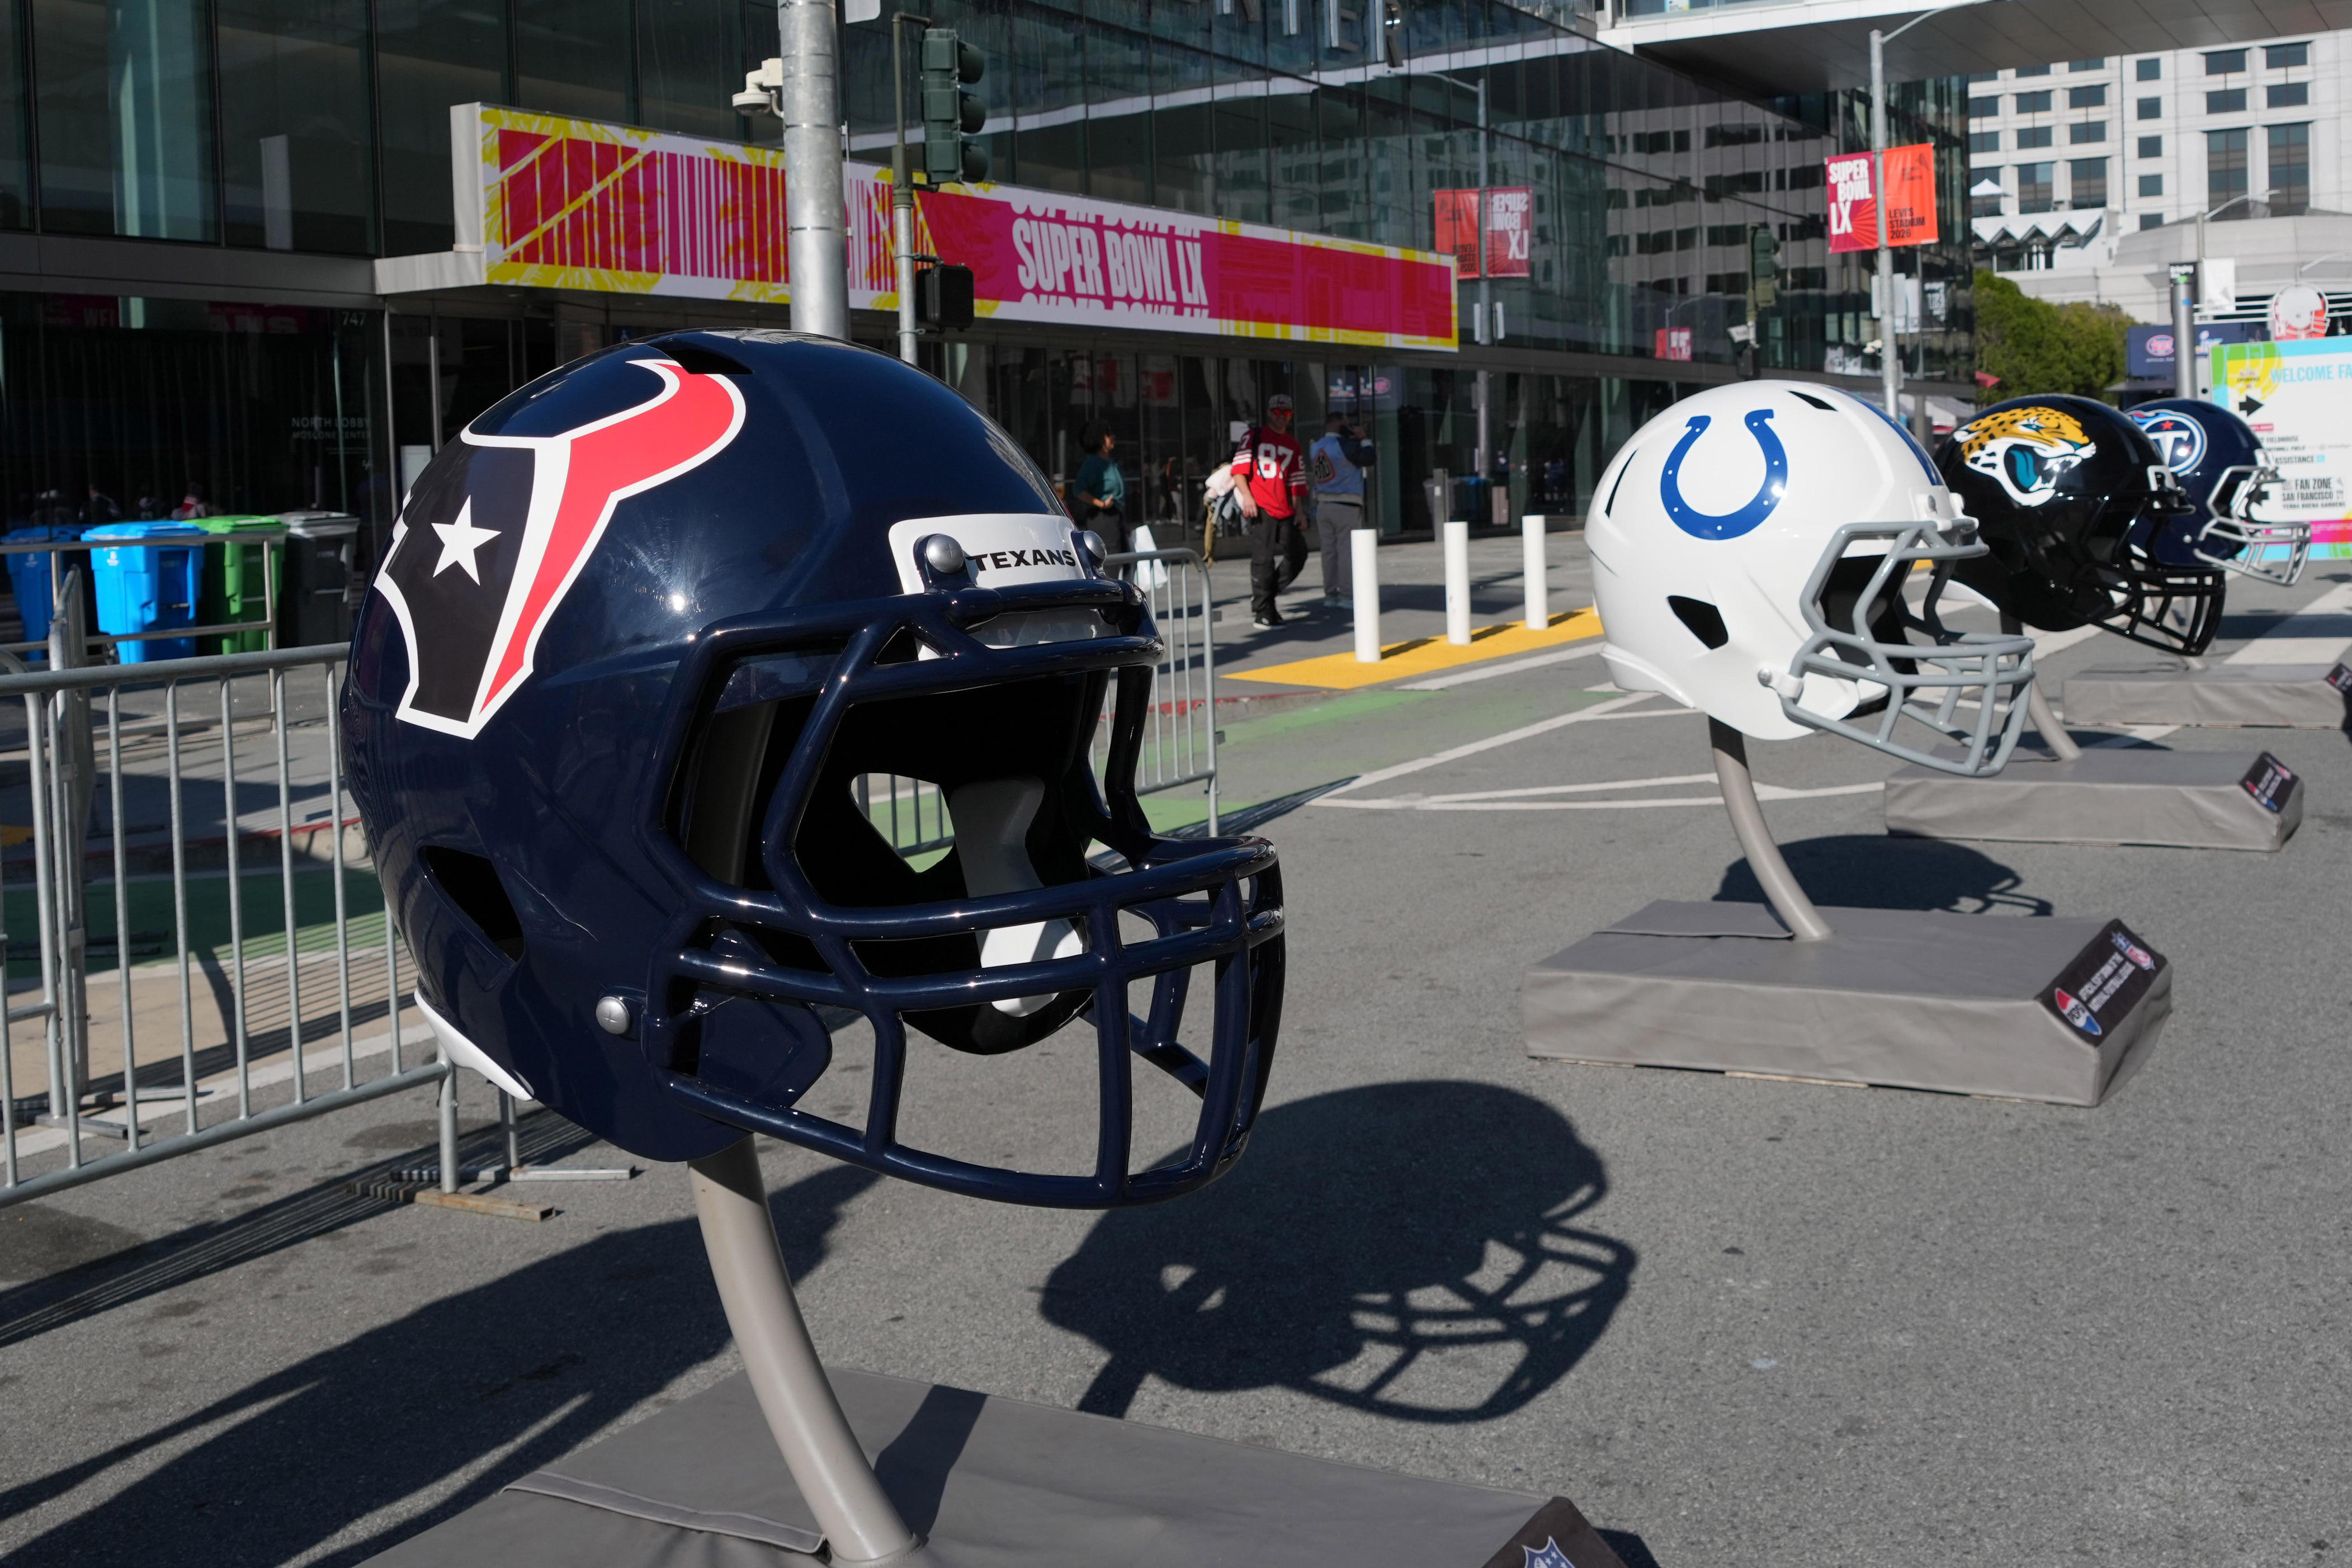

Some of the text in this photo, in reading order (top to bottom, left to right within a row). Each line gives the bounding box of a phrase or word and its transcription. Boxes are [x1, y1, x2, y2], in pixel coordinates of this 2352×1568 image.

[1829, 158, 1869, 184] SUPER
[1837, 179, 1872, 202] BOWL
[1830, 201, 1853, 235] LX
[1888, 207, 1914, 219] LEVI'S
[1890, 216, 1925, 229] STADIUM
[1890, 229, 1911, 239] 2026
[1012, 218, 1106, 296] SUPER
[1104, 230, 1177, 303] BOWL
[1175, 239, 1208, 305] LX
[342, 311, 366, 326] 747
[2270, 365, 2334, 383] WELCOME
[292, 416, 332, 428] NORTH
[1256, 443, 1294, 479] 87
[2275, 456, 2314, 464] ASSISTANCE
[2295, 479, 2310, 490] FAN
[2313, 478, 2332, 489] ZONE
[2282, 493, 2295, 502] SAN
[2297, 490, 2333, 500] FRANCISCO
[965, 549, 1076, 572] TEXANS
